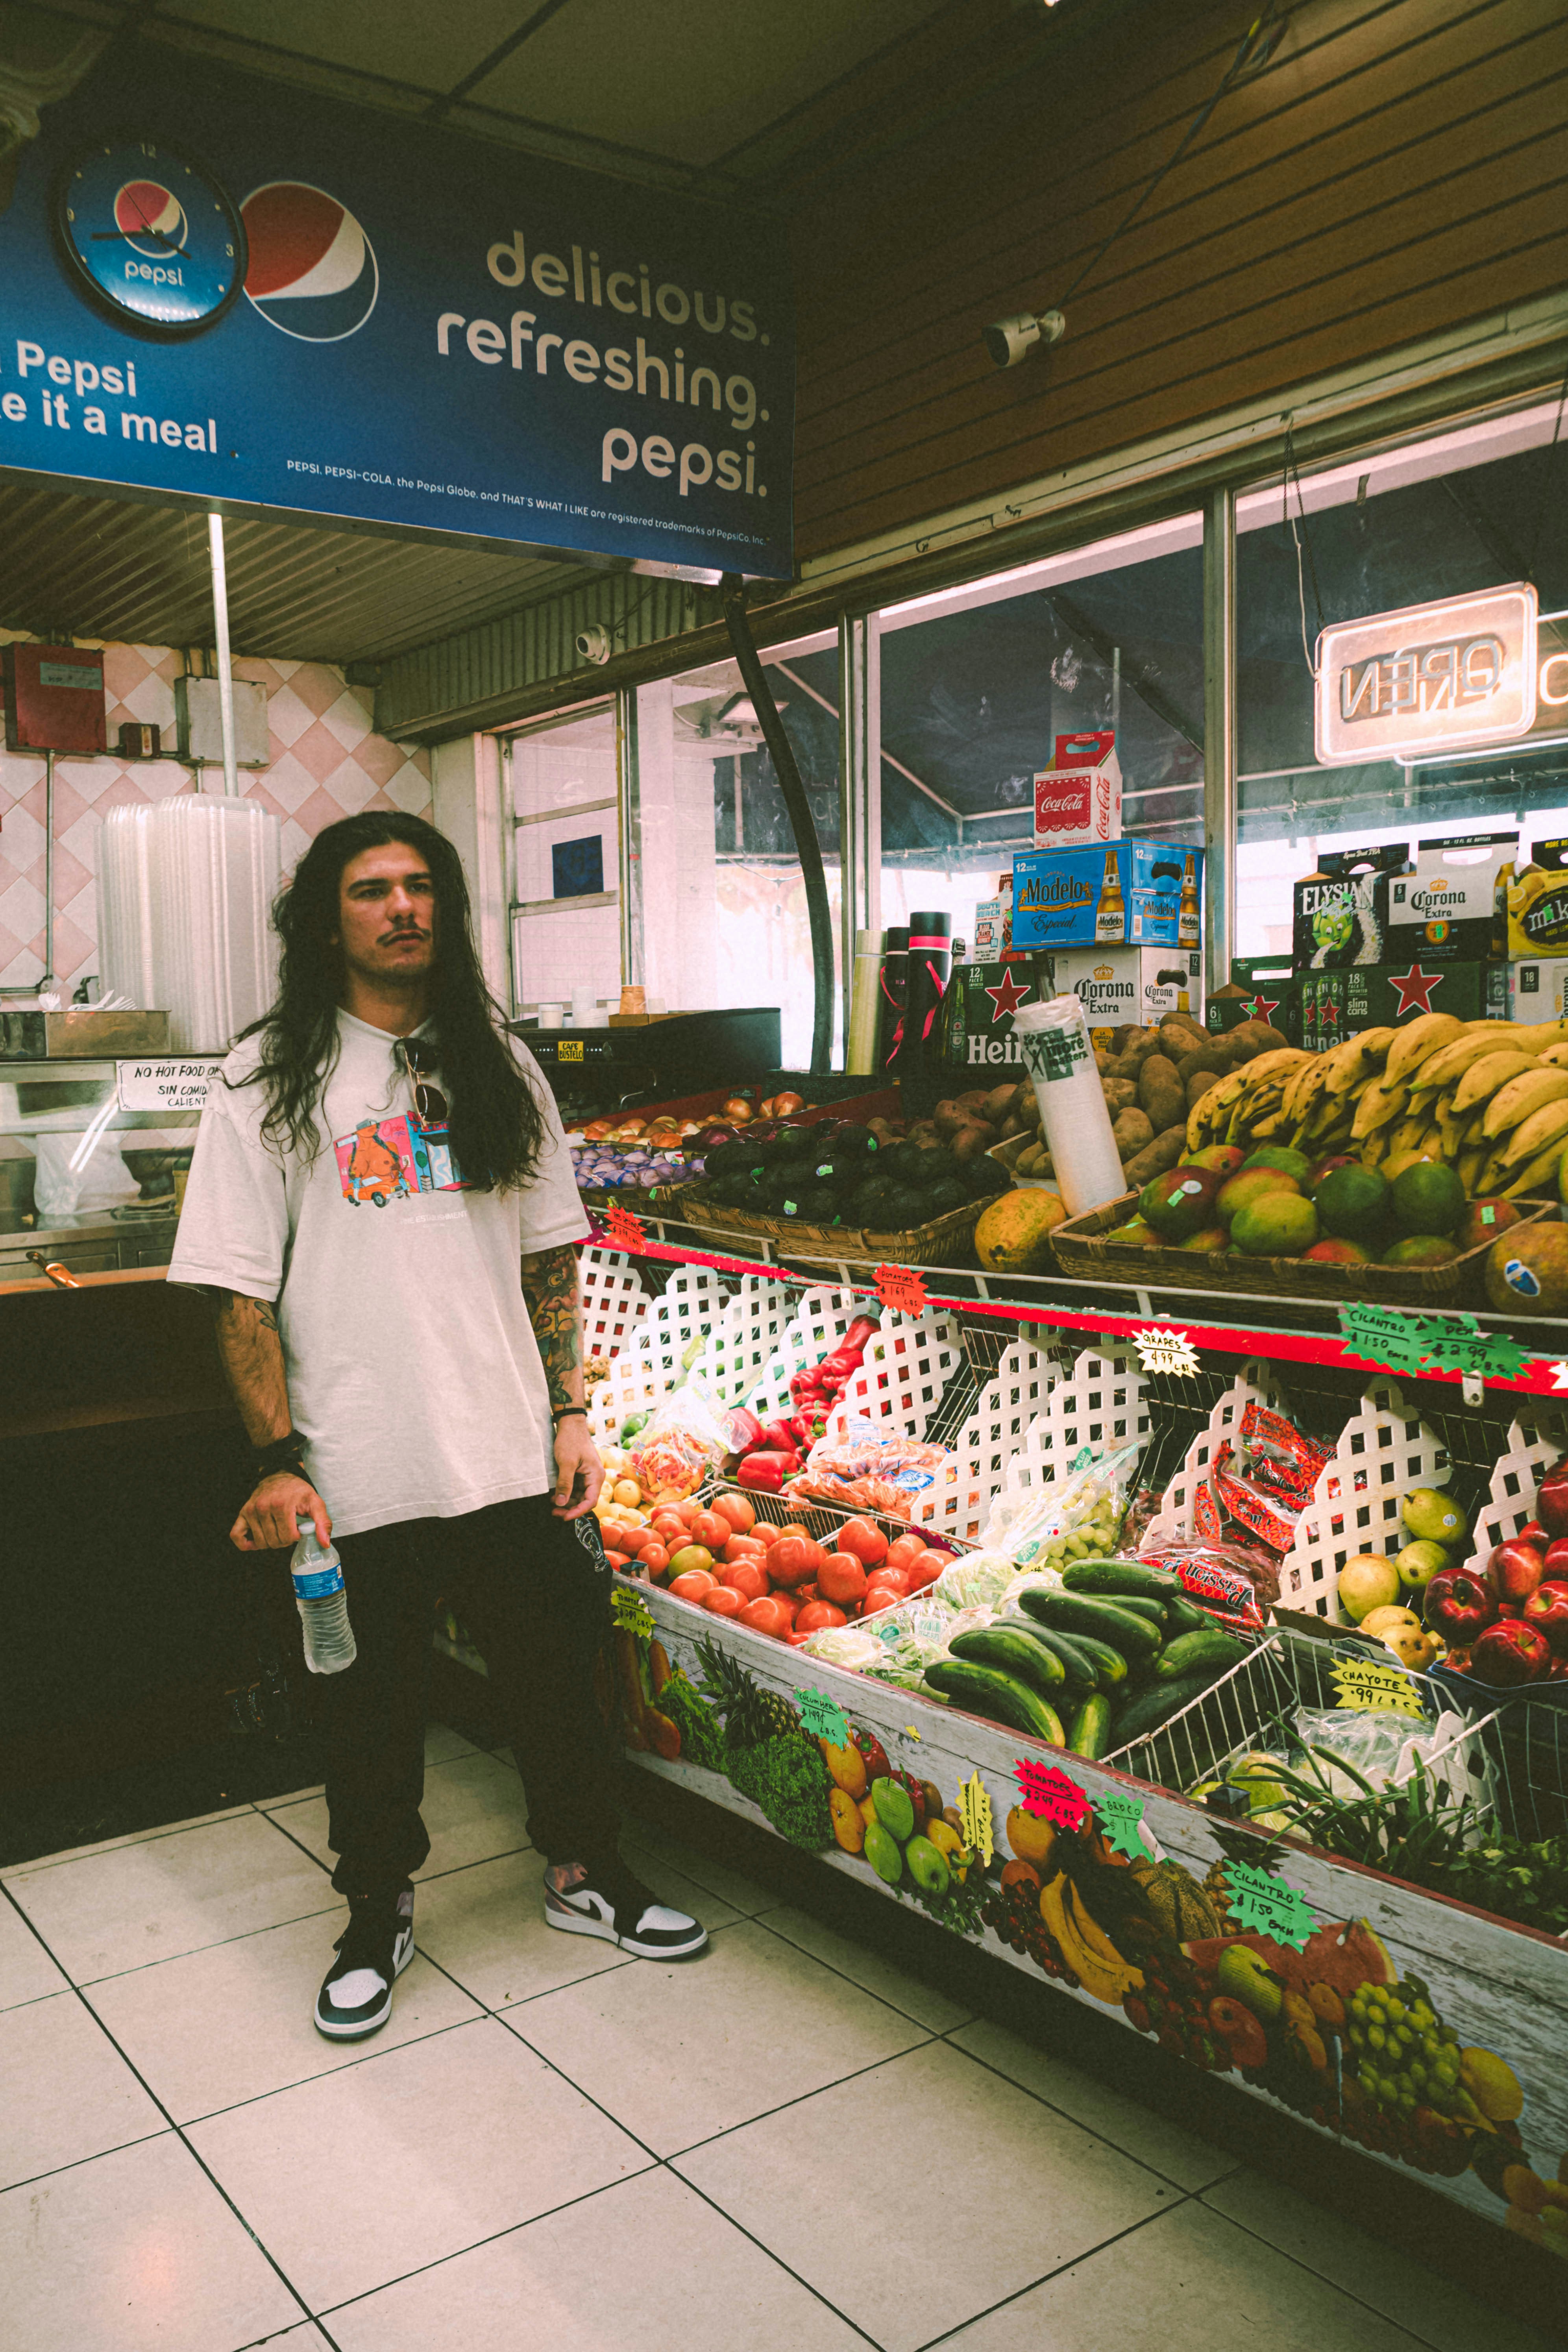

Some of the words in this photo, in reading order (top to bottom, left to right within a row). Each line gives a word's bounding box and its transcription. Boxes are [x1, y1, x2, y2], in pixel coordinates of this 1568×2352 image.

[124, 261, 183, 286] pepsi
[486, 229, 770, 346] delicious.
[17, 339, 136, 397] Pepsi
[437, 310, 770, 431] refreshing.
[42, 389, 70, 429] it
[83, 410, 107, 436] a
[121, 412, 218, 454] meal
[602, 427, 767, 497] pepsi.
[397, 477, 414, 489] the
[417, 479, 445, 494] Pepsi
[481, 492, 499, 502] and
[501, 493, 534, 508] THAT'S
[536, 499, 562, 513] WHAT
[564, 503, 568, 513] I
[569, 504, 589, 516] LIKE
[590, 510, 606, 519] are
[608, 512, 653, 527] registered
[655, 520, 705, 536] trademarks
[707, 528, 716, 537] of
[1041, 793, 1085, 813] Coca-Cola
[1135, 849, 1144, 860] 12
[1016, 862, 1026, 873] 12
[1027, 875, 1083, 903] Modelo
[1302, 878, 1374, 916] ELYSIAN
[1397, 885, 1402, 895] 6
[1147, 900, 1173, 916] Modelo
[1411, 890, 1467, 910] Corona
[1100, 915, 1122, 926] Modelo
[1424, 907, 1452, 919] Extra
[1192, 956, 1198, 966] 12
[969, 967, 981, 978] 12
[1348, 973, 1360, 984] 18
[1525, 971, 1535, 982] 18
[1073, 978, 1135, 1005] Corona
[1145, 984, 1173, 998] Corona
[1089, 1000, 1119, 1014] Extra
[1152, 996, 1167, 1005] Extra
[1347, 997, 1368, 1009] slim
[1210, 1006, 1217, 1019] 6
[1347, 1007, 1368, 1015] cans
[559, 1050, 583, 1060] BUSTELO
[1046, 1037, 1085, 1058] more
[134, 1067, 152, 1078] NO
[155, 1066, 178, 1077] HOT
[179, 1065, 205, 1077] FOOD
[157, 1085, 178, 1095] SIN
[180, 1085, 208, 1095] COMID
[881, 1270, 913, 1284] POTATOES
[880, 1285, 886, 1294] $
[1349, 1309, 1405, 1333] CILANTRO
[1143, 1334, 1181, 1350] GRAPES
[1151, 1350, 1173, 1365] 4.99
[1431, 1344, 1445, 1358] $
[1450, 1344, 1487, 1361] 2.99
[1185, 1562, 1254, 1610] Passion
[1342, 1671, 1400, 1690] CHAYOTE
[1351, 1687, 1373, 1704] .99
[799, 1694, 838, 1714] CUCUMBER
[802, 1707, 807, 1716] $
[1024, 1769, 1073, 1797] TOMATOES
[1106, 1801, 1141, 1816] BROCO
[1233, 1869, 1294, 1904] CILANTRO
[1236, 1893, 1244, 1907] $
[1250, 1898, 1273, 1916] 1.50
